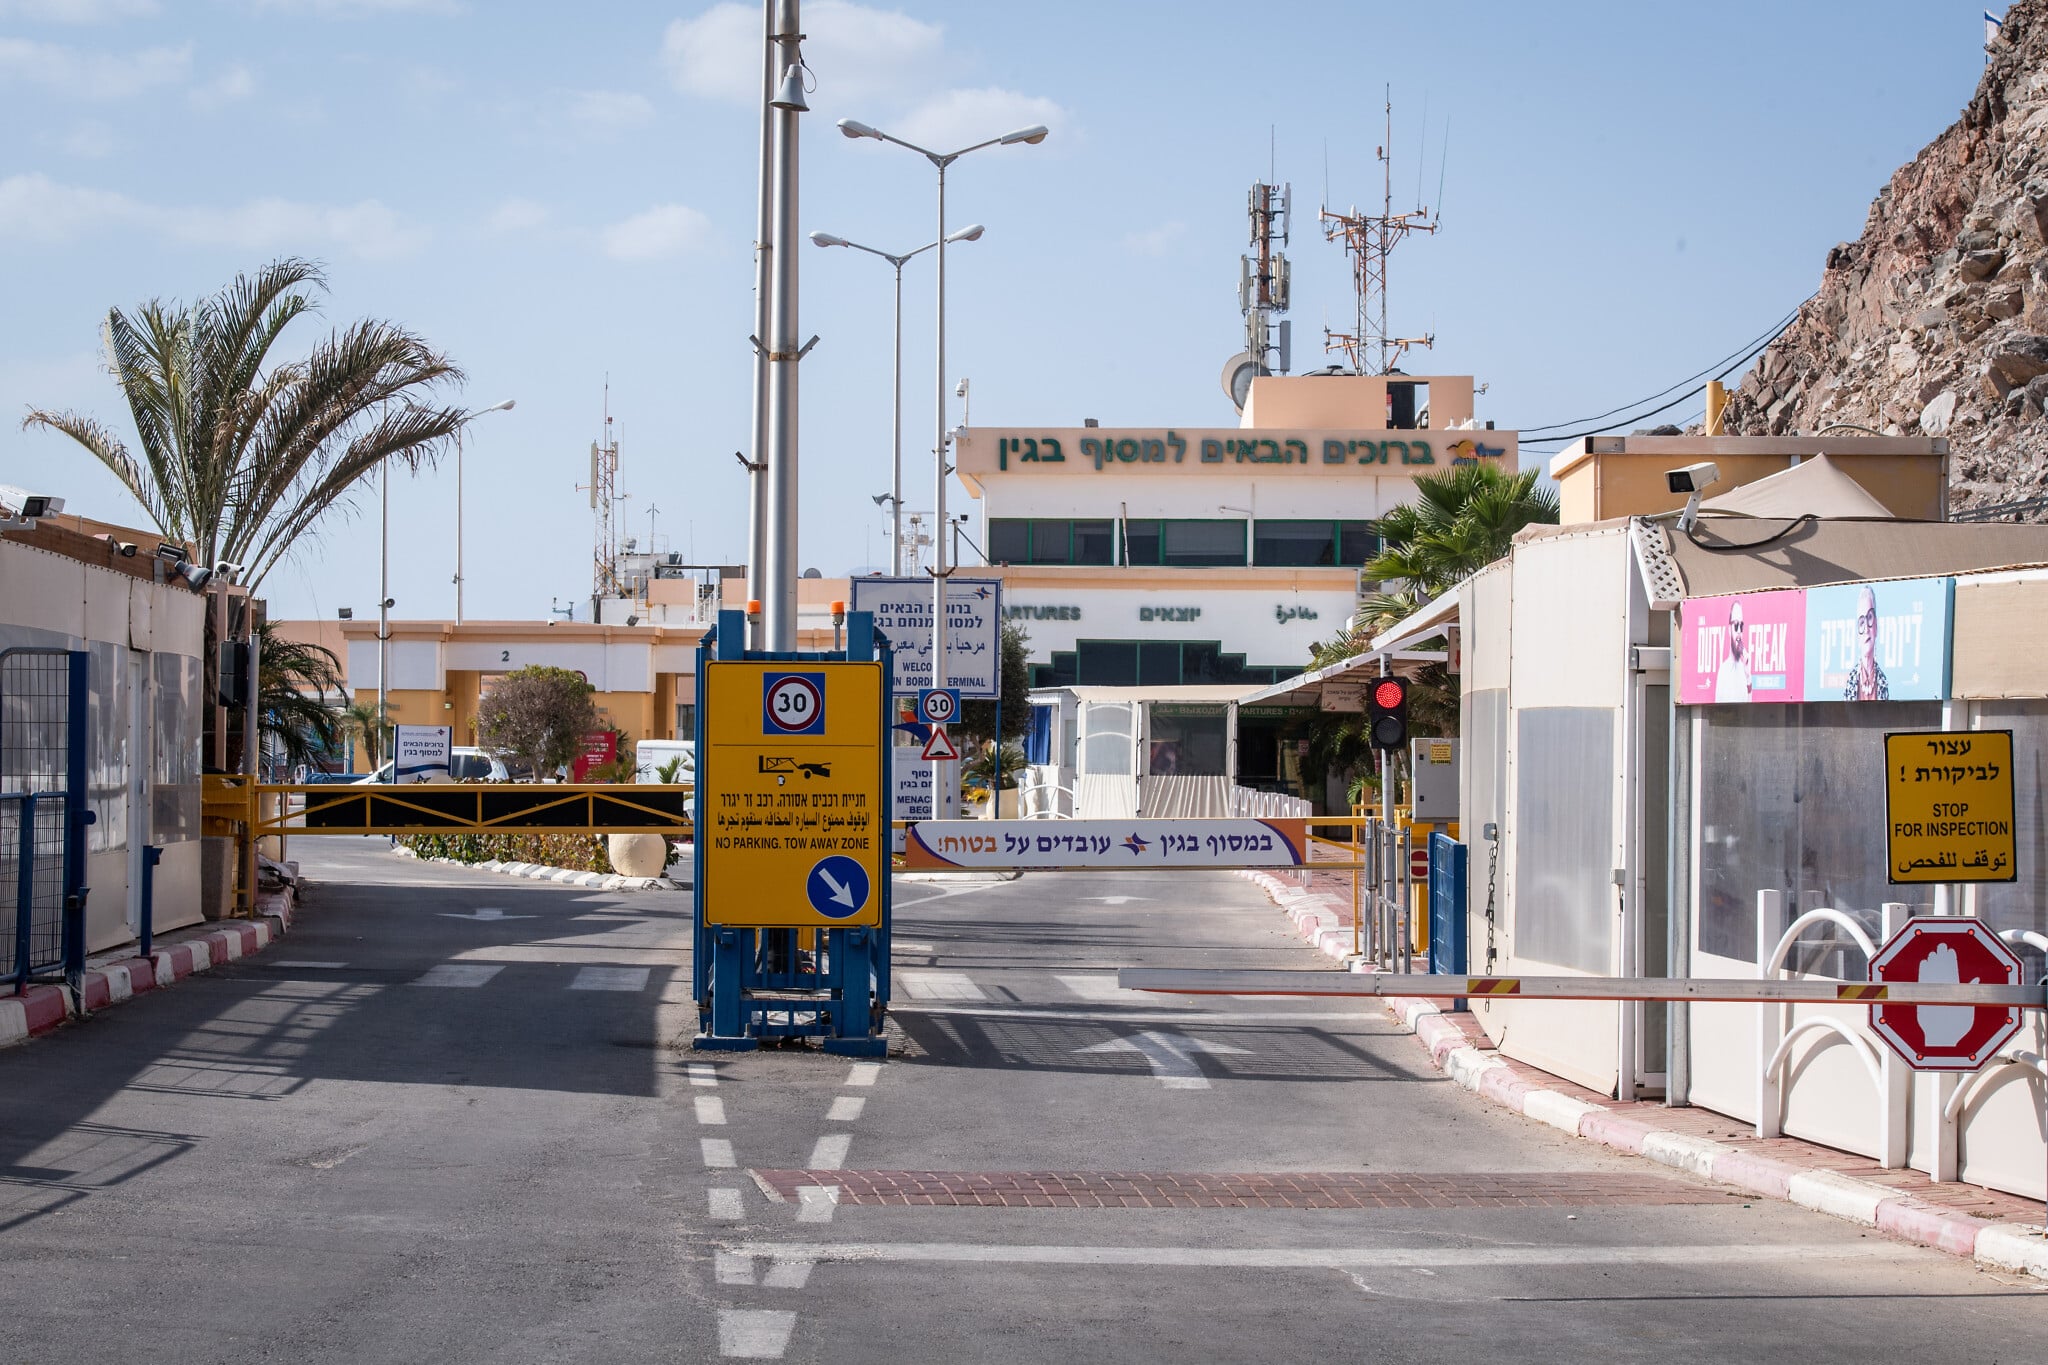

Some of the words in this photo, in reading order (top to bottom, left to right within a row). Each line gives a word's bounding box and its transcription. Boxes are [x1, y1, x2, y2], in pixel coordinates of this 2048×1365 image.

[999, 438, 1066, 471] בגין
[1080, 431, 1186, 471] למסוף
[1201, 439, 1308, 463] הבאים
[1323, 440, 1435, 464] ברוכים
[880, 603, 923, 614] הבאים
[1002, 605, 1081, 621] ARTURES
[1140, 607, 1201, 622] יוצאים
[1276, 604, 1318, 625] مغادرة
[874, 616, 893, 627] בגי
[898, 617, 933, 628] מנחם
[946, 615, 983, 630] למסו
[1697, 625, 1726, 673] DUTY
[1748, 622, 1787, 672] FREAK
[1879, 613, 1923, 668] דיוטי
[501, 650, 510, 662] 2
[1820, 618, 1856, 688] פריק
[902, 661, 932, 672] WELCO
[906, 676, 933, 687] BORD
[947, 677, 986, 688] ERMINAL
[777, 692, 807, 713] 30
[930, 699, 949, 712] 30
[1239, 707, 1284, 715] PARTURES
[404, 749, 418, 757] בגין
[419, 749, 443, 757] למסוף
[1927, 740, 1971, 756] עצור
[1915, 762, 1999, 786] לביקורת
[900, 781, 918, 790] בגין
[720, 793, 740, 808] יגרר
[744, 793, 753, 808] זר
[757, 793, 773, 808] רכב
[812, 793, 838, 808] רכבים
[842, 793, 866, 808] חניית
[909, 805, 932, 814] BEGI
[1933, 803, 1969, 817] STOP
[822, 812, 845, 832] ممنوع
[847, 811, 870, 832] الوقوف
[1895, 823, 1922, 837] FOR
[1926, 821, 2008, 836] INSPECTION
[715, 837, 731, 849] NO
[733, 837, 782, 849] PARKING.
[784, 837, 809, 849] TOW
[810, 837, 839, 849] AWAY
[841, 837, 870, 849] ZONE
[938, 835, 997, 854] בטוח!
[1004, 832, 1030, 855] על
[1036, 834, 1111, 855] עובדים
[1160, 834, 1200, 858] בגין
[1206, 834, 1273, 857] במסוף
[1898, 852, 1957, 873] للفحص
[1962, 849, 2007, 871] توقف
